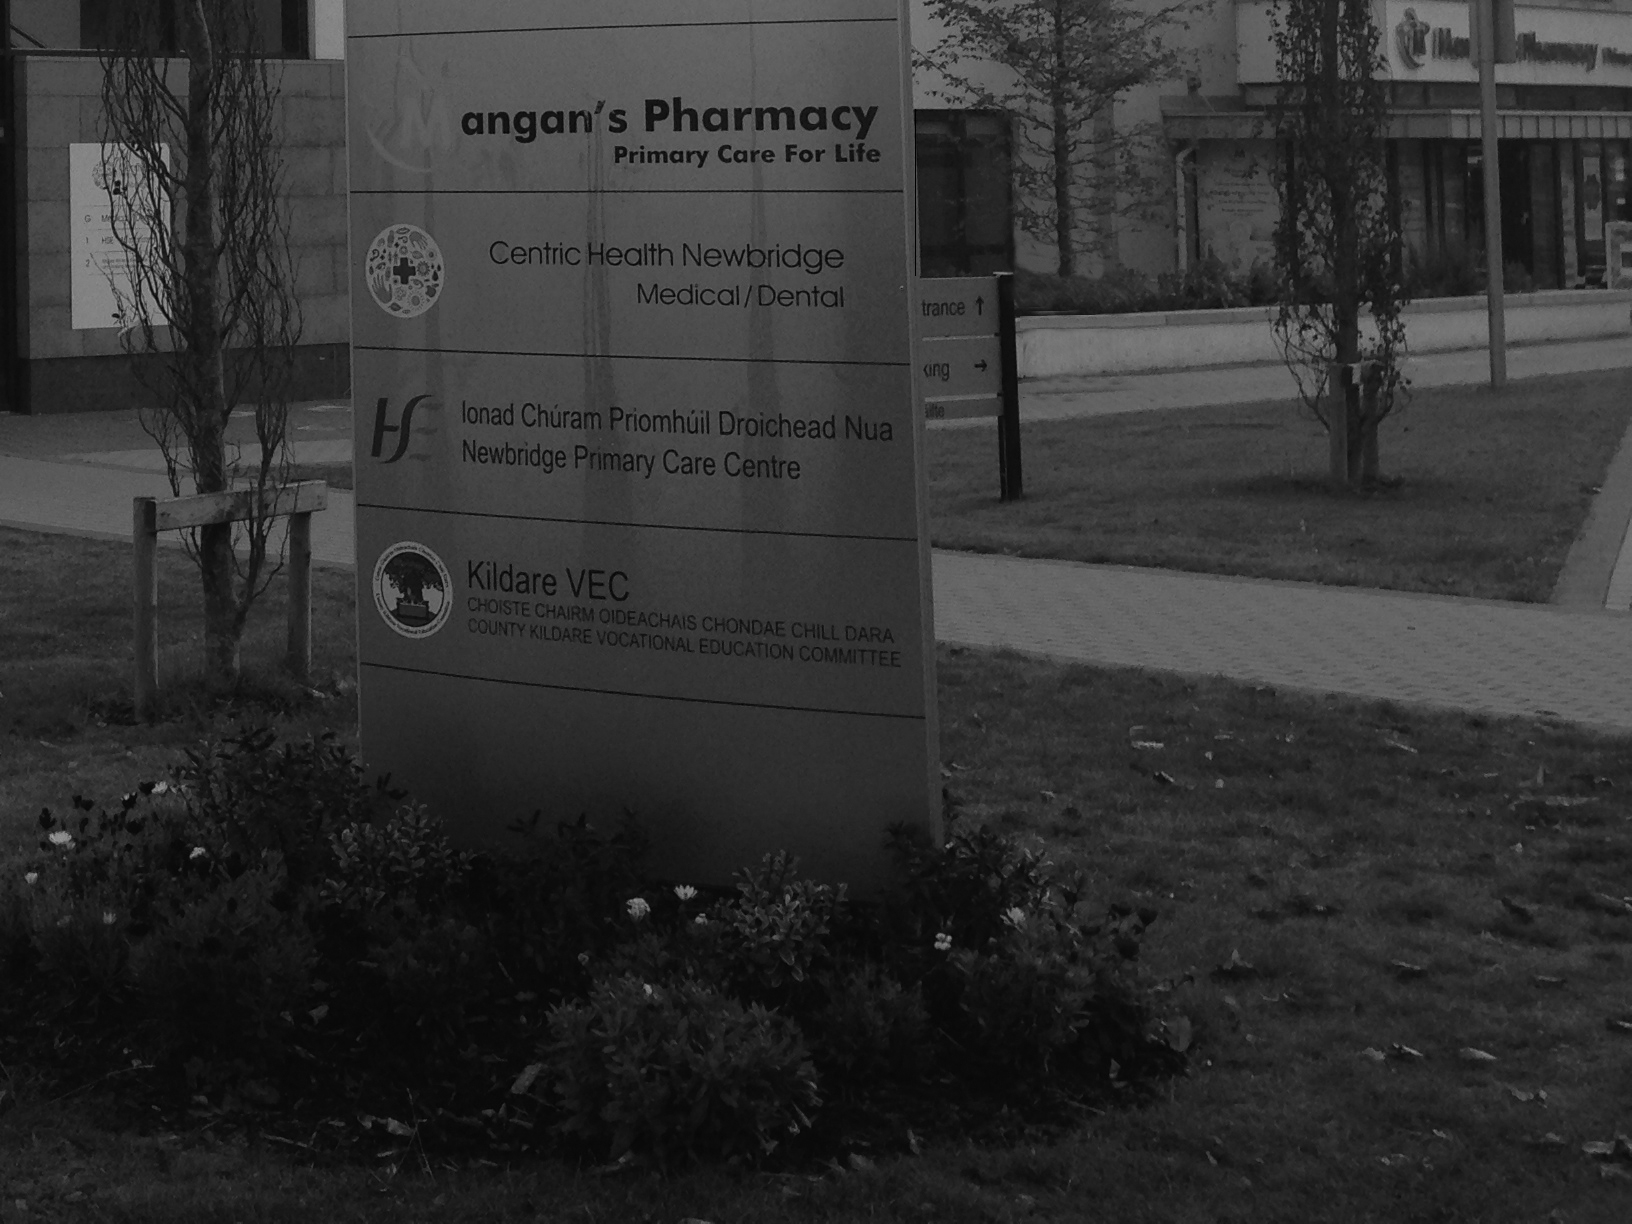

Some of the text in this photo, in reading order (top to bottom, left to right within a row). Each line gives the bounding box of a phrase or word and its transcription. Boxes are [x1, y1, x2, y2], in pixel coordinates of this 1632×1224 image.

[645, 96, 879, 140] Pharmacy
[614, 143, 881, 169] Primary Care For Life
[489, 241, 844, 275] Centric Health Newbridge
[462, 400, 514, 426] Ionad
[521, 403, 602, 430] Chúram
[719, 411, 835, 439] Droichead
[845, 415, 892, 441] Nua
[463, 439, 800, 479] Newbridge Primary Care Centre
[468, 560, 629, 601] Kildare VEC
[468, 597, 894, 643] CHOISTE CHAIRM OIDEACHAIS CHONDAE CHILL DARA
[469, 618, 901, 667] COUNTY KILDARE VOCATIONAL EDUCATION COMMITTEE
